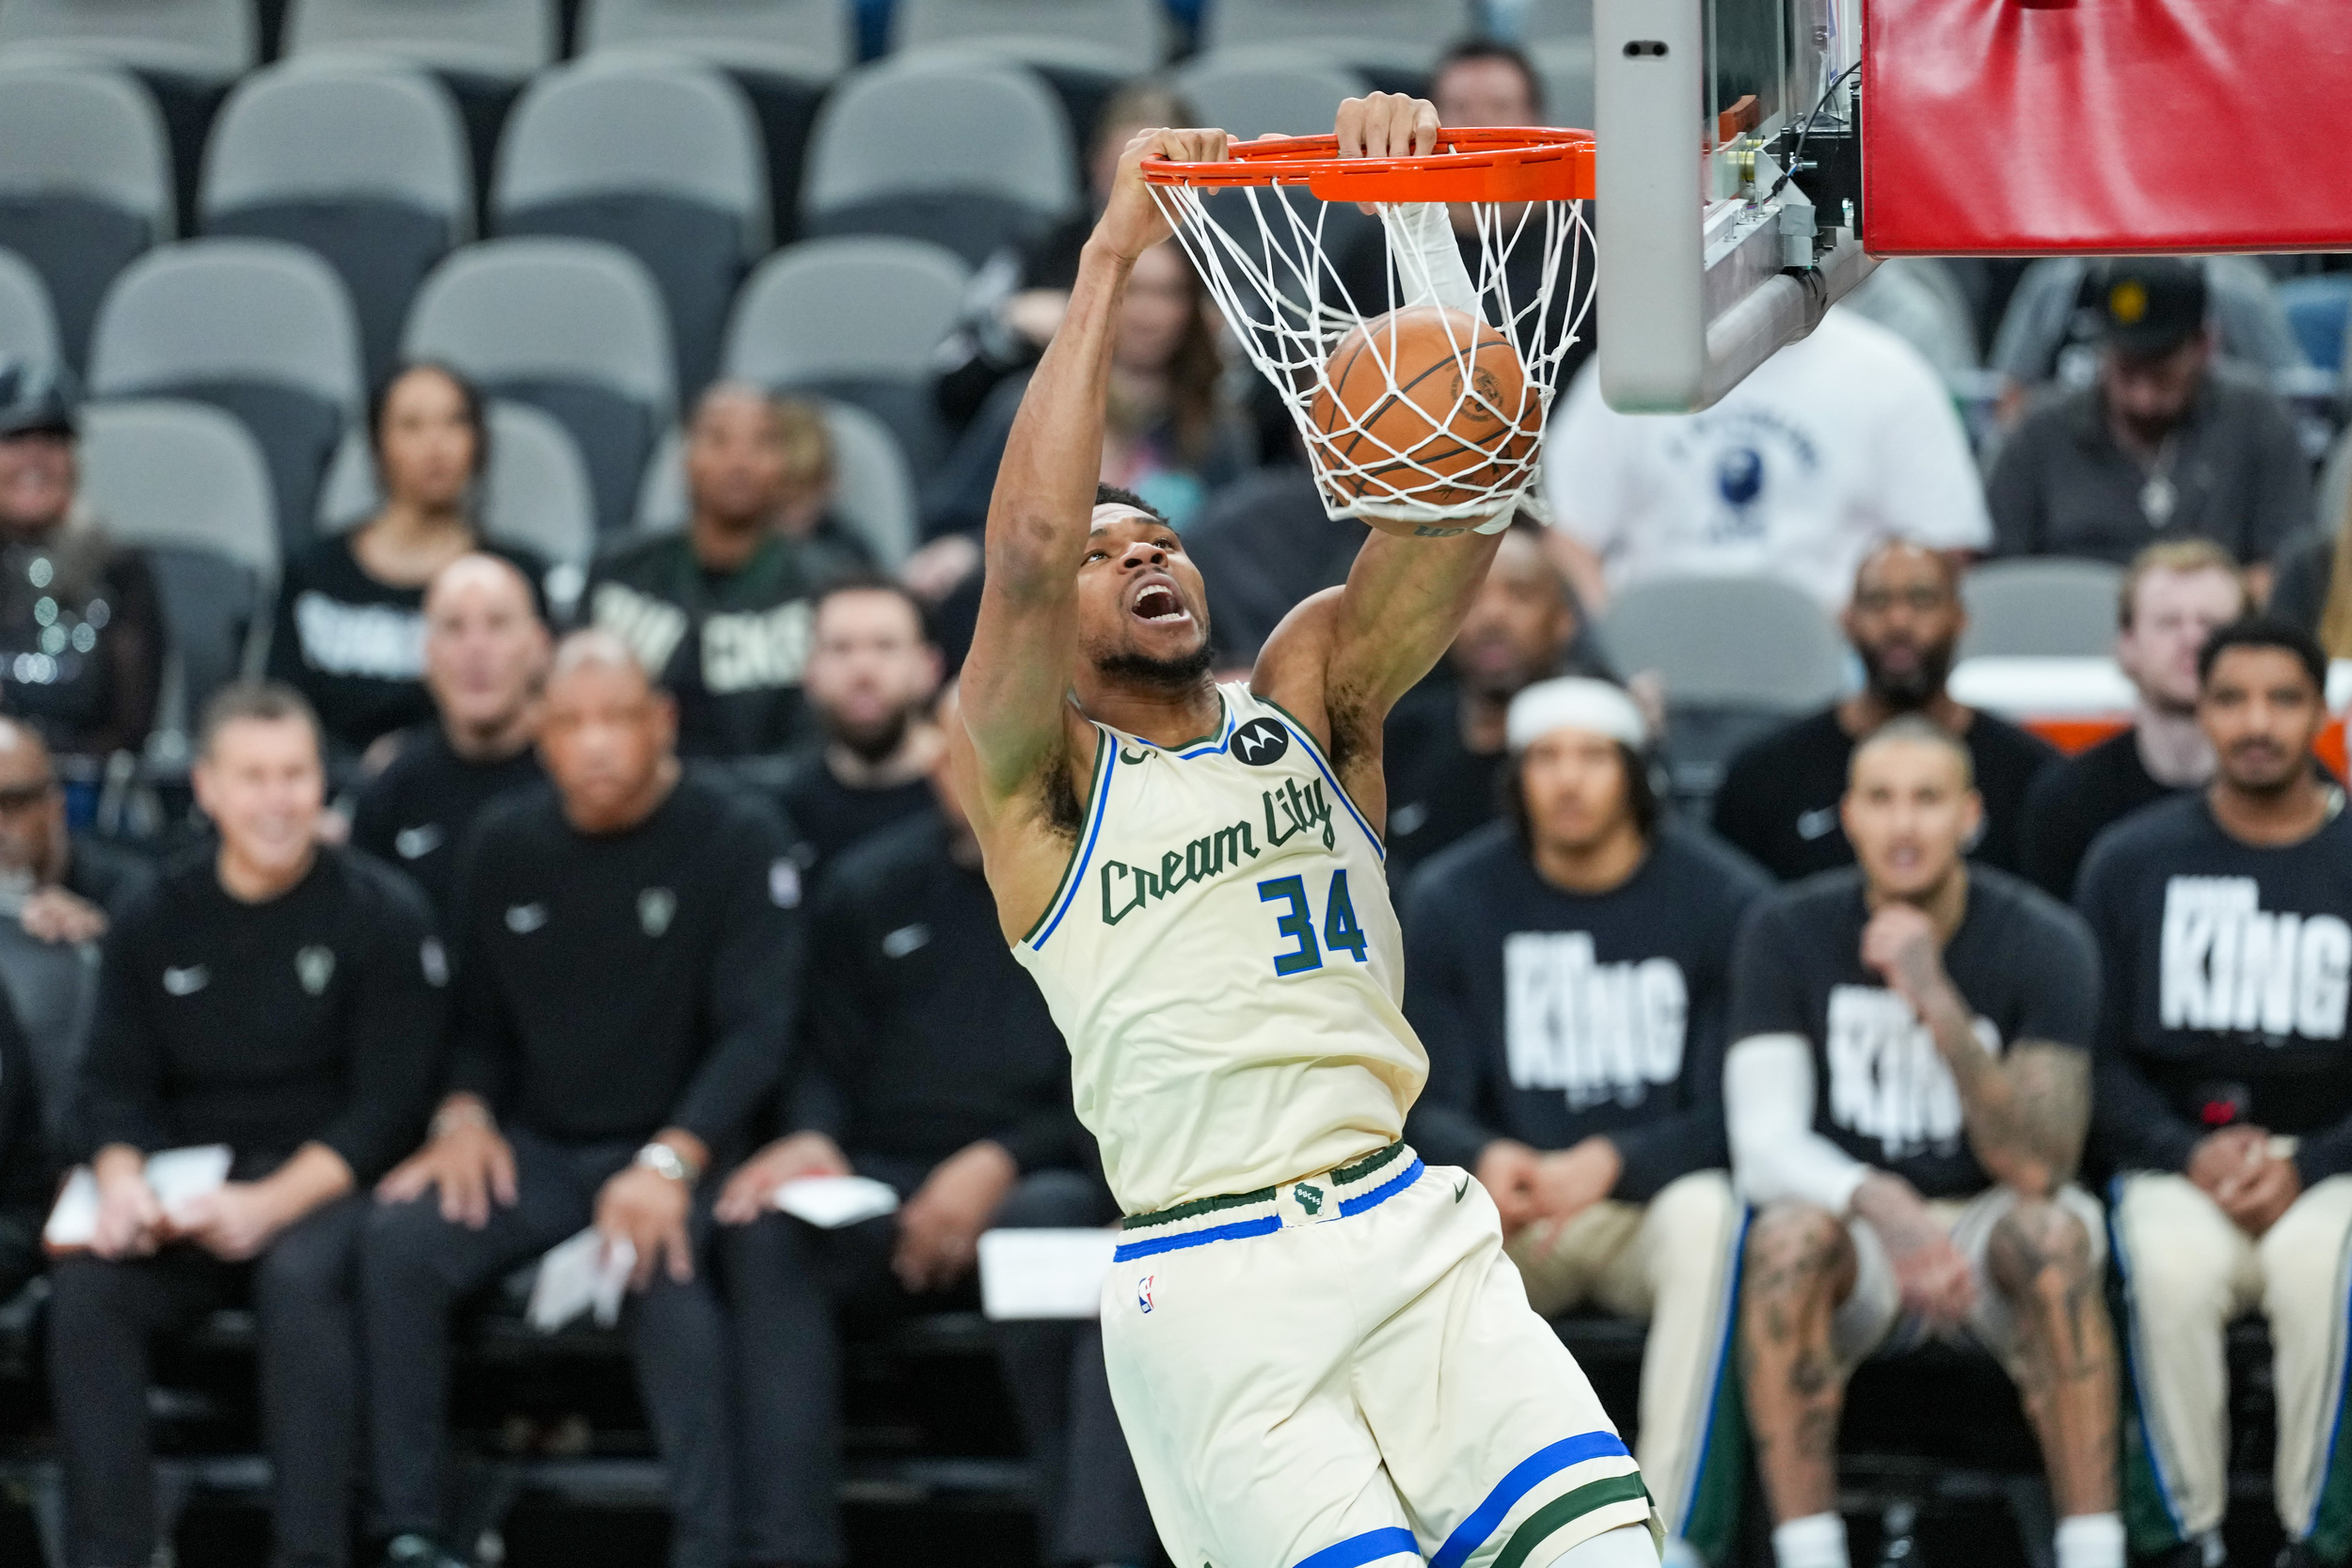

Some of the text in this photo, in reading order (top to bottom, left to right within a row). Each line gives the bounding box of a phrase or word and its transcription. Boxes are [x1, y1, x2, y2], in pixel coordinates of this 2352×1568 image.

[1101, 777, 1335, 927] Cream City
[1257, 869, 1368, 976] 34
[2160, 905, 2352, 1039] KING
[1503, 952, 1690, 1087] KING
[1297, 1188, 1321, 1206] BUCKS
